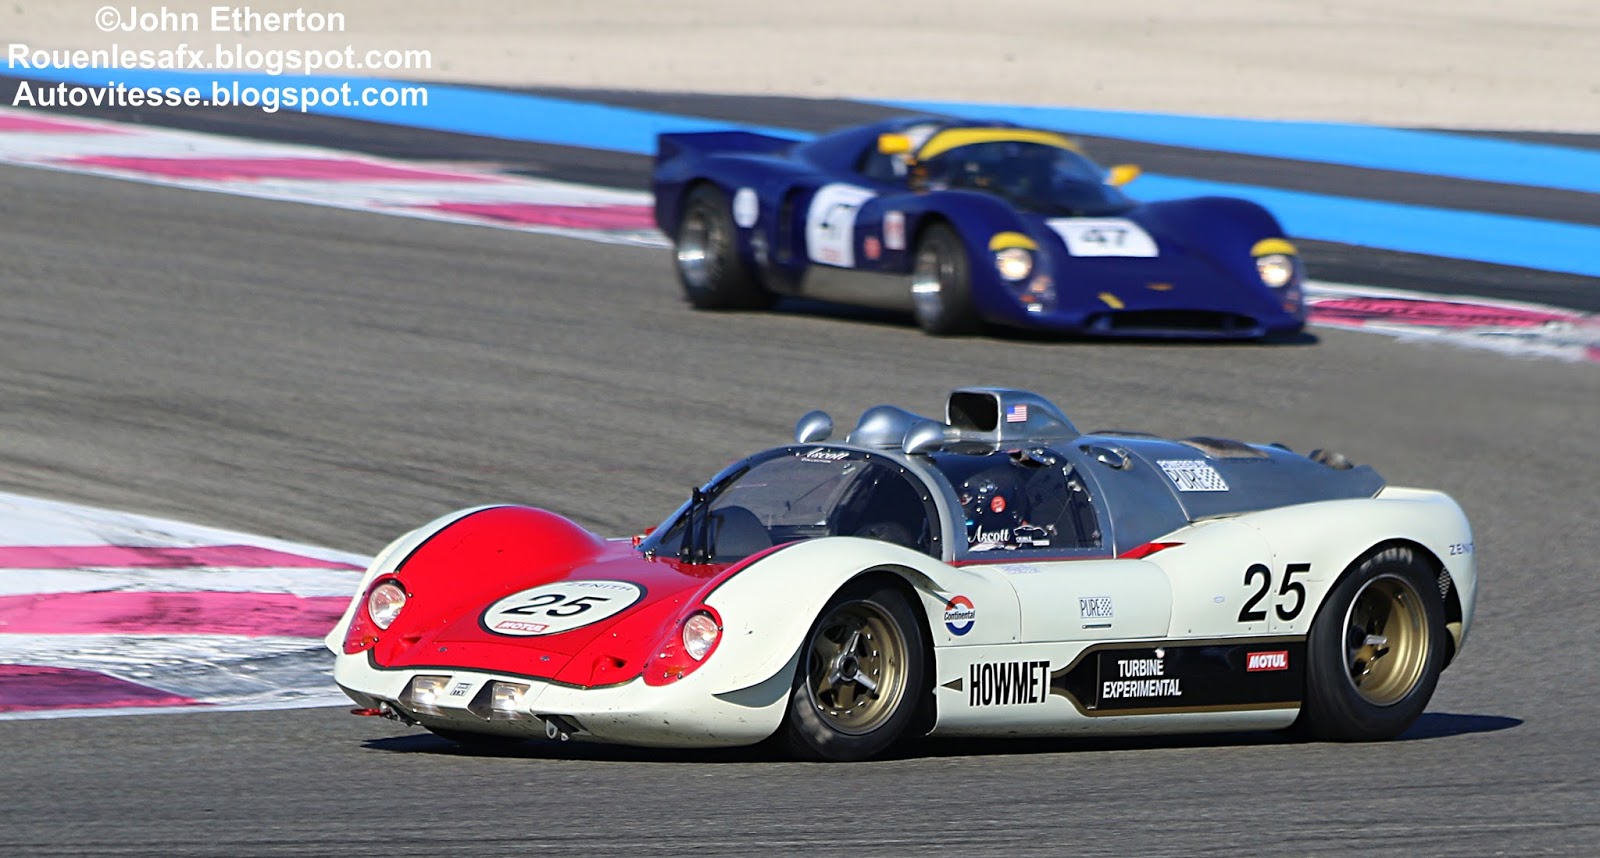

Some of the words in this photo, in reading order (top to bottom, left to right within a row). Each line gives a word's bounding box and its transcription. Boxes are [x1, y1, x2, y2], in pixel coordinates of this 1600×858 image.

[1081, 228, 1128, 247] 47
[802, 447, 850, 460] Ascott
[1165, 469, 1209, 490] PURE
[967, 525, 1010, 543] Ascott
[566, 583, 634, 592] ZENITH
[1237, 563, 1312, 622] 25
[500, 594, 612, 617] 25
[1080, 599, 1101, 616] PURE
[944, 610, 976, 620] Continental
[500, 623, 545, 631] MOTUL
[1118, 659, 1164, 677] TURBINE
[1249, 655, 1286, 669] MOTUL
[969, 660, 1050, 706] HOWMET
[1103, 679, 1182, 698] EXPERIMENTAL
